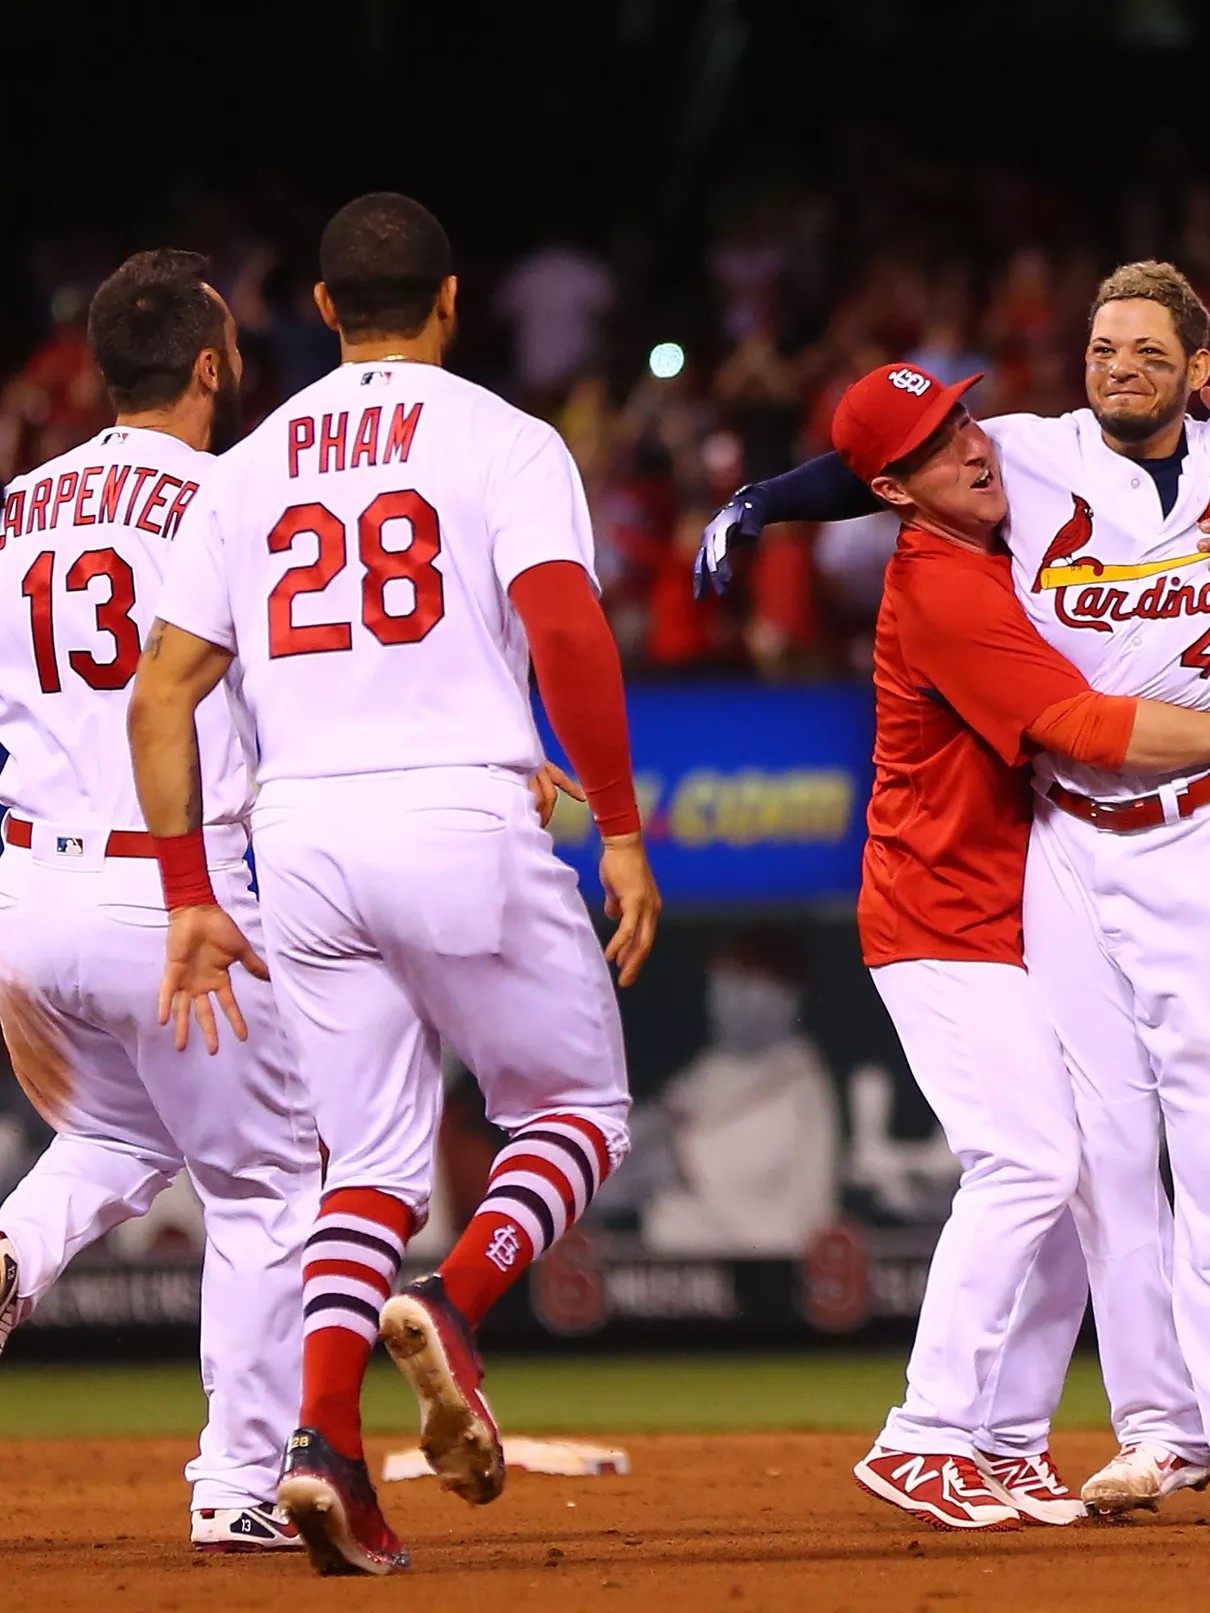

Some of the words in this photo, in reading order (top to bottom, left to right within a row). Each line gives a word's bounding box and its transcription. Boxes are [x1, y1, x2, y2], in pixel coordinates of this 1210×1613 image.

[288, 402, 424, 478] PHAM
[0, 464, 200, 549] ARPENTER
[21, 547, 138, 693] 13
[267, 488, 445, 660] 28
